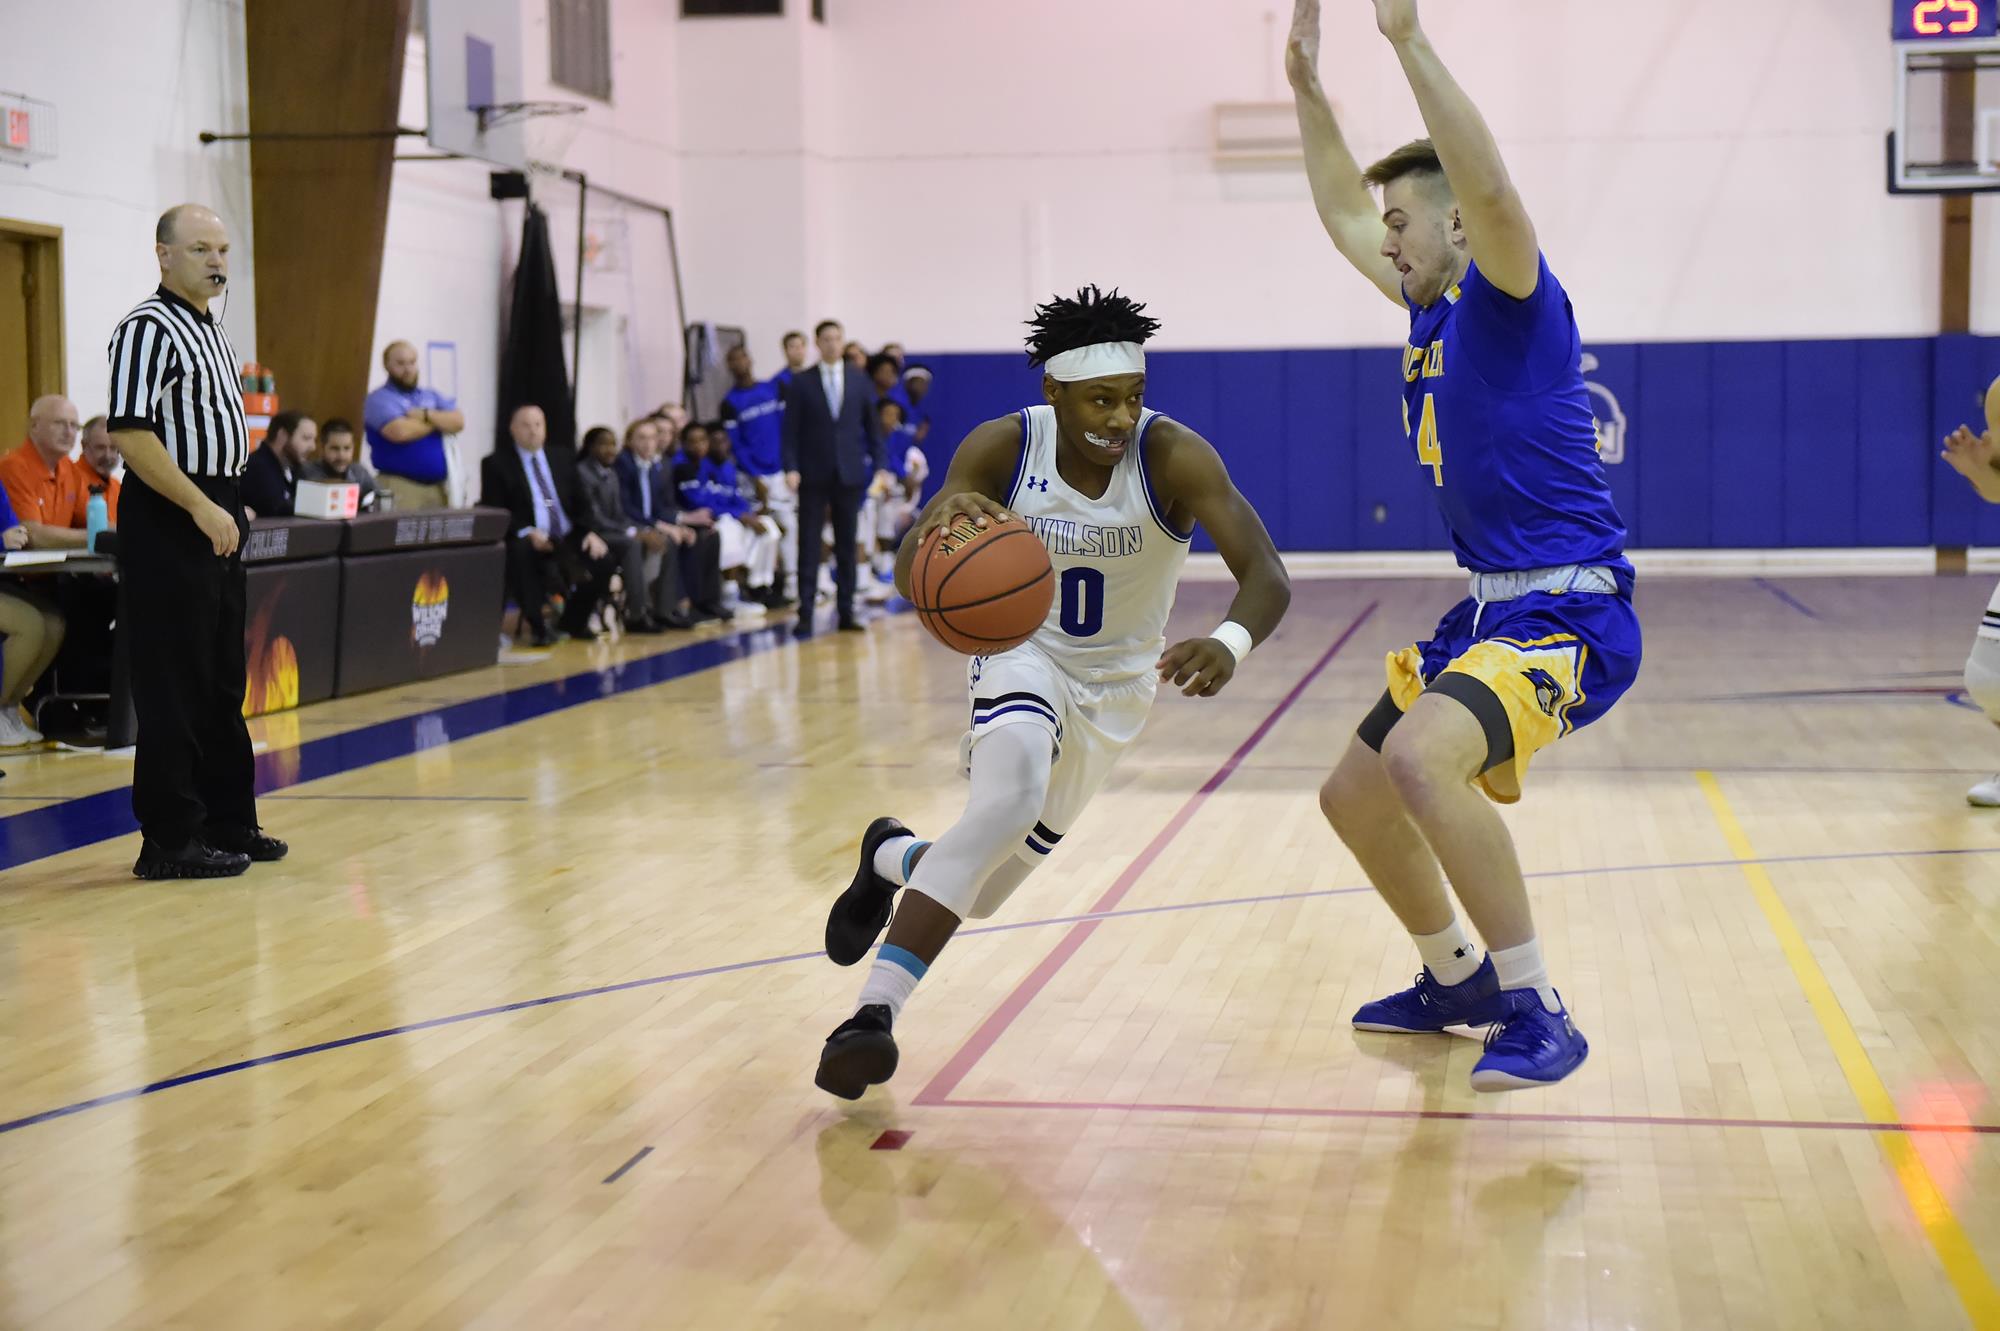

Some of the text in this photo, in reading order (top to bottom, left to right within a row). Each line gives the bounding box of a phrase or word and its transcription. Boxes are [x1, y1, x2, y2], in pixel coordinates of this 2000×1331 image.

[1913, 0, 1979, 34] 25
[1402, 393, 1444, 487] 4
[1024, 515, 1143, 557] WILSON
[412, 602, 448, 623] WILSON
[1060, 566, 1105, 637] 0
